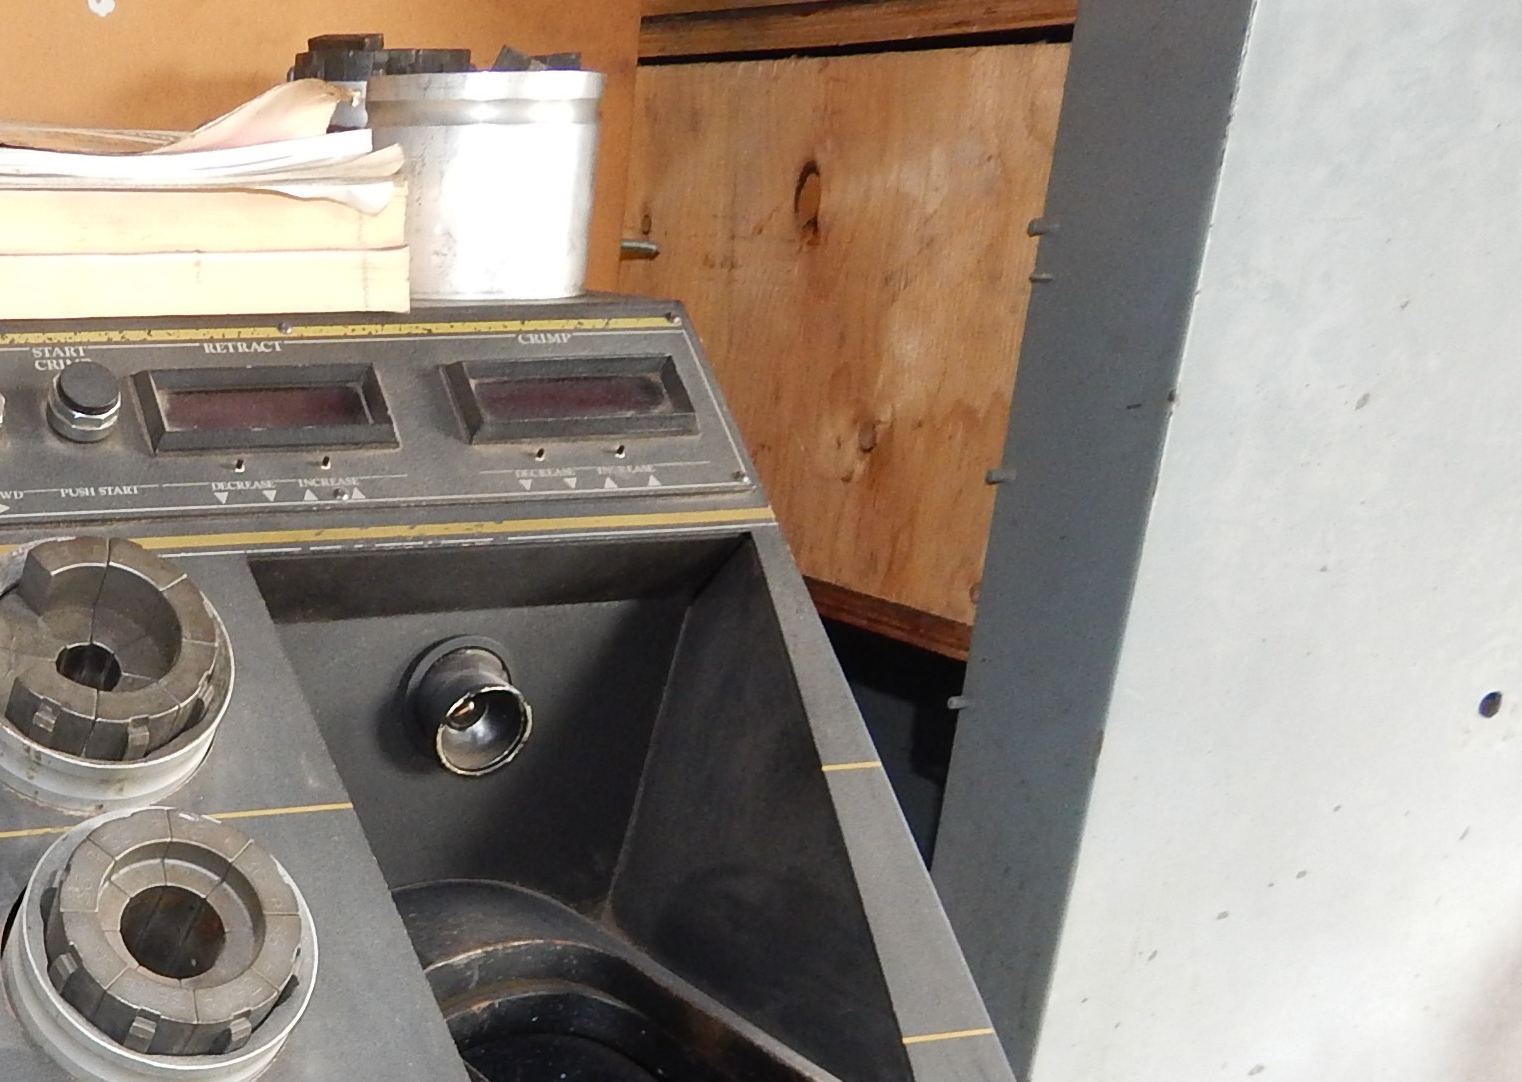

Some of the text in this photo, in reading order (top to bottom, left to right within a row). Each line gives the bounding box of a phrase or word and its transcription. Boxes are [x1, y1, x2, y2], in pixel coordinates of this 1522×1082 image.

[518, 332, 572, 345] CRIMP
[32, 346, 87, 358] START
[204, 341, 284, 354] RETRACT
[34, 358, 92, 371] CRI
[211, 480, 277, 491] DECREASE
[298, 476, 360, 488] INCREASE
[60, 485, 140, 498] PUSH START
